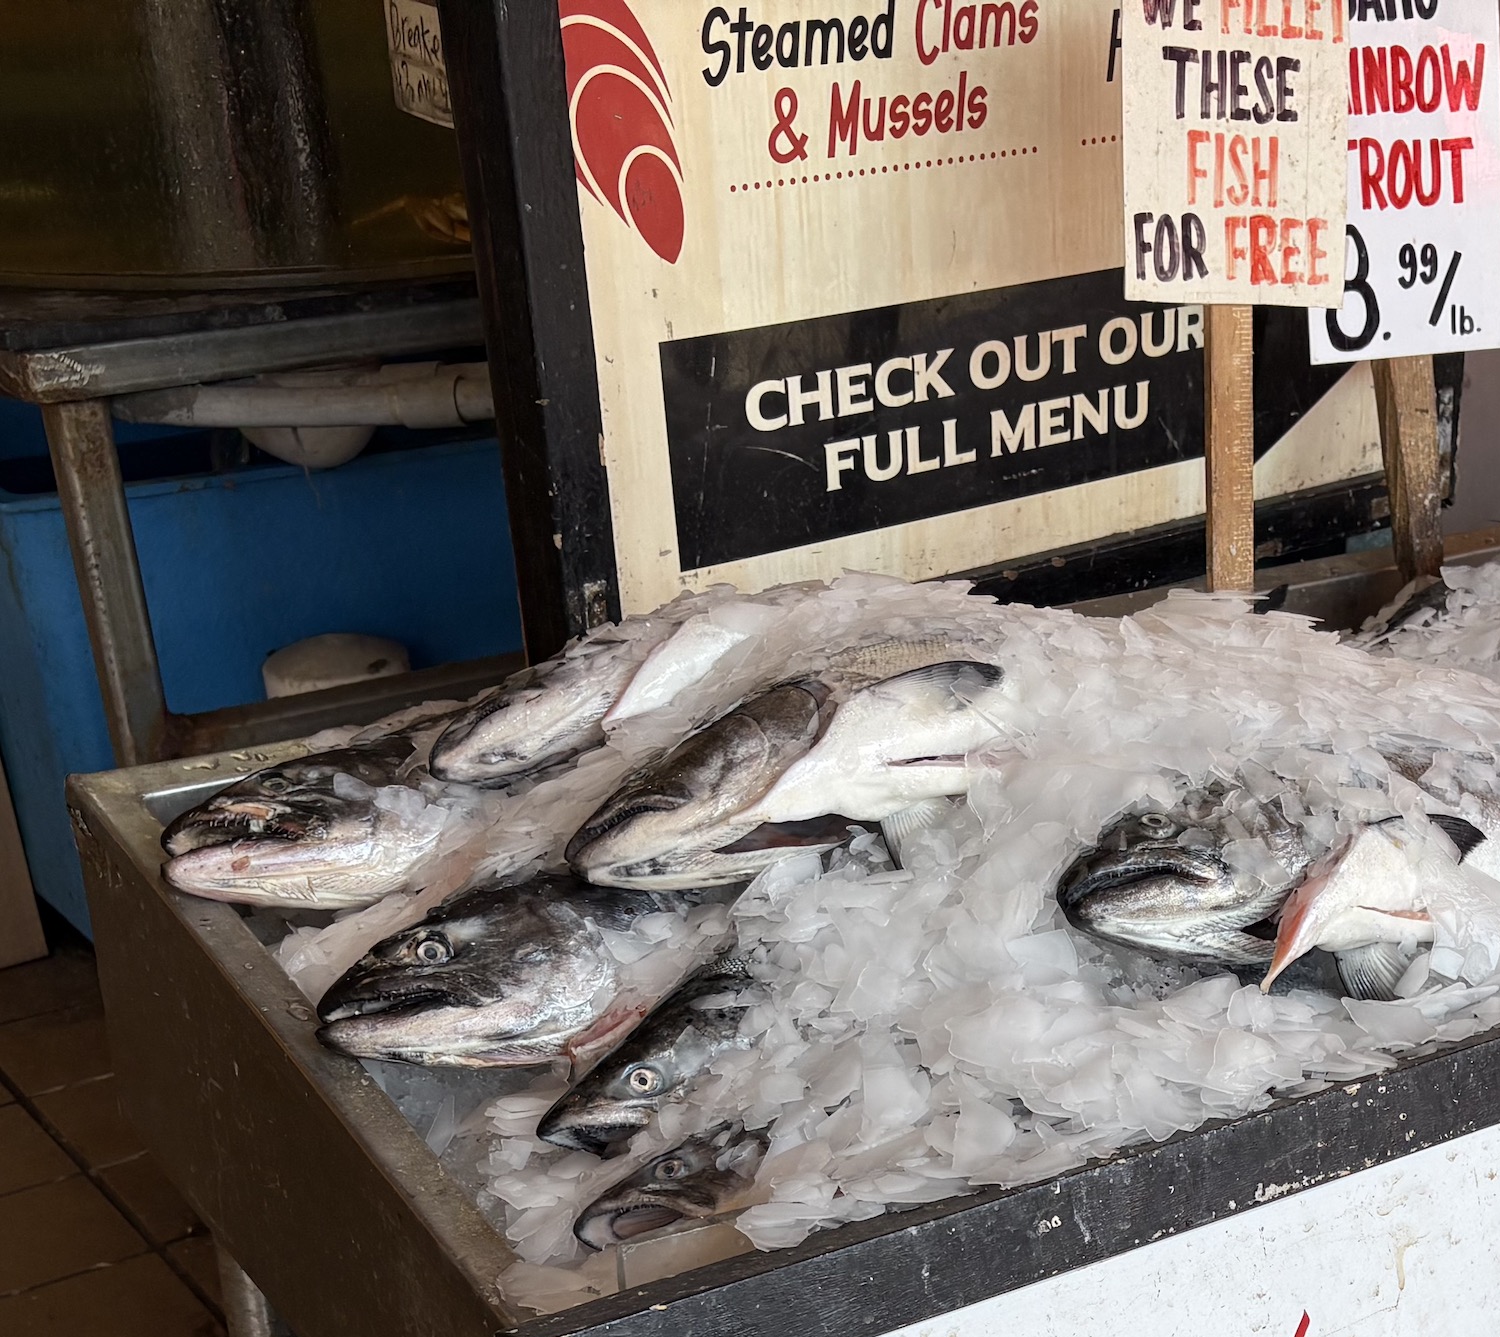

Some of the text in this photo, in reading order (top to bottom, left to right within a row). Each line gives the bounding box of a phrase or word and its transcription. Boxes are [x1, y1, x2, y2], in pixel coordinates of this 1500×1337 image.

[701, 0, 896, 88] Steamed
[915, 0, 1040, 66] Clams
[1162, 45, 1301, 123] THESE
[768, 70, 989, 165] & Mussels
[1186, 130, 1279, 209] FISH
[1133, 212, 1330, 286] FOR FREE
[744, 305, 1205, 434] CHECK OUT OUR
[825, 381, 1150, 494] FULL MENU
